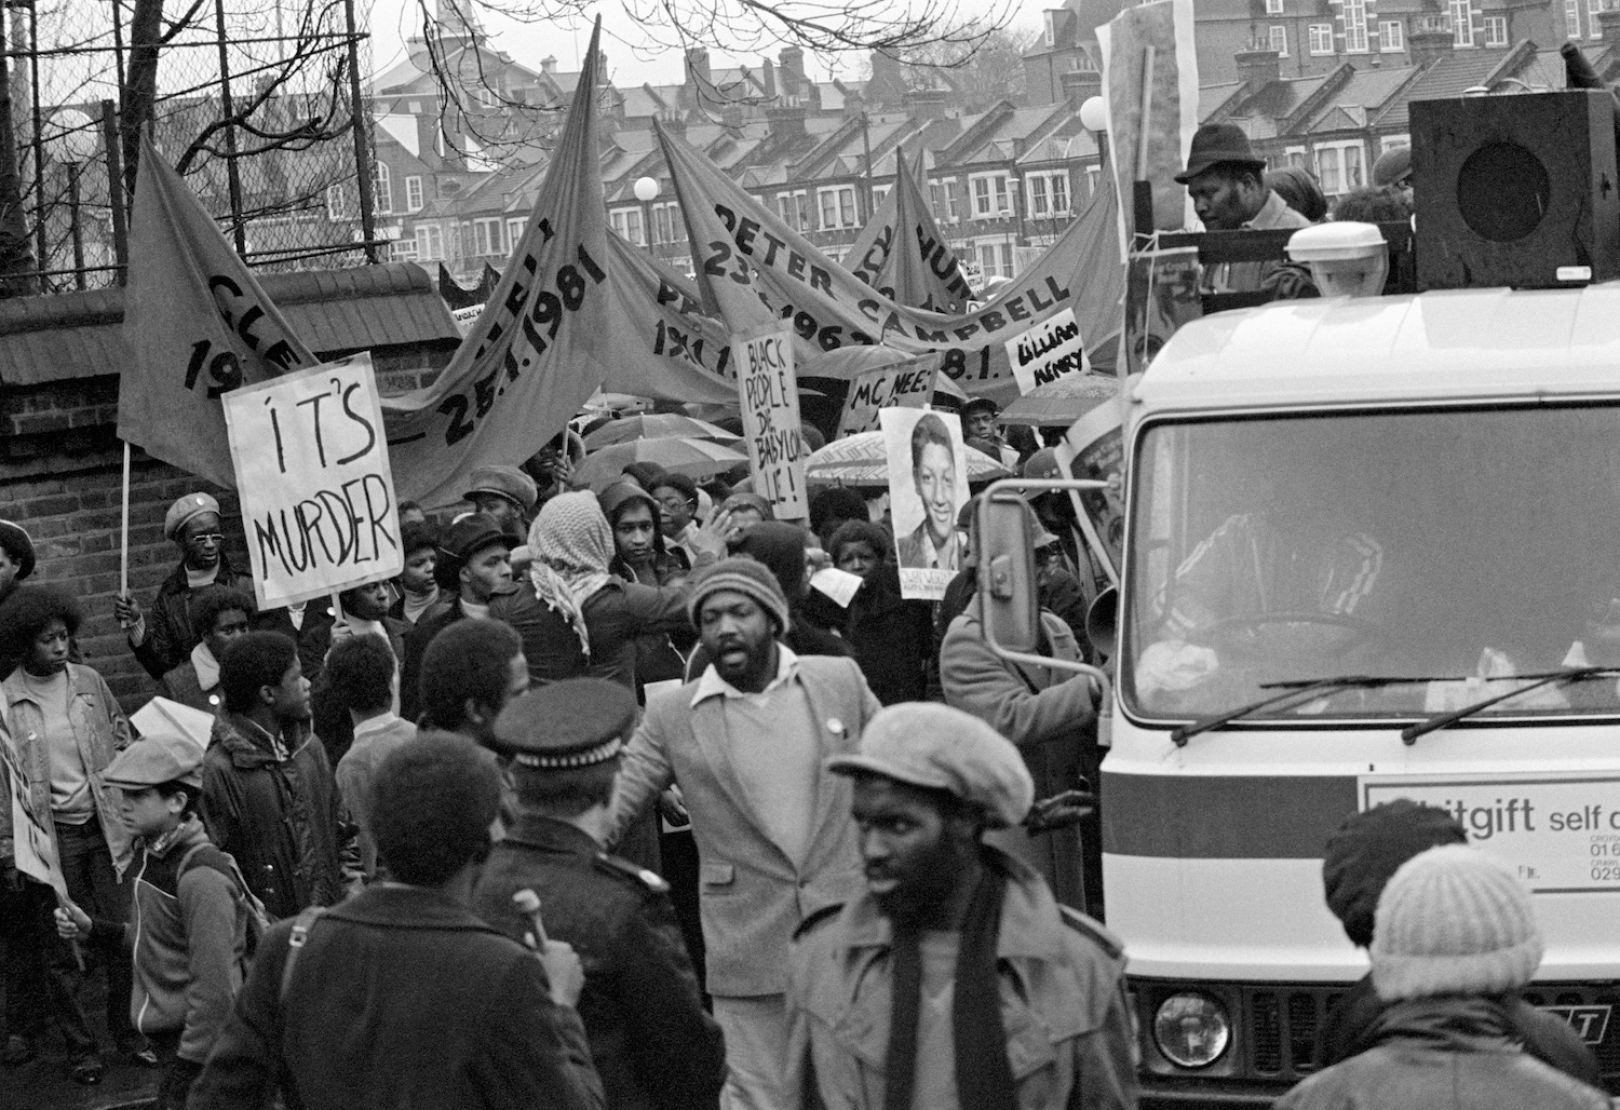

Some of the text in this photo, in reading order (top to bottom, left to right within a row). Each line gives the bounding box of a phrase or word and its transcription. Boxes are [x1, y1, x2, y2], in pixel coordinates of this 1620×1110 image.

[714, 203, 1071, 343] PETER CAMPBELL
[747, 338, 786, 375] BLACK
[1033, 347, 1082, 388] HENRY
[745, 370, 790, 412] PEOPLE
[850, 377, 887, 410] MC
[252, 472, 397, 582] MURDER
[1549, 804, 1602, 832] self
